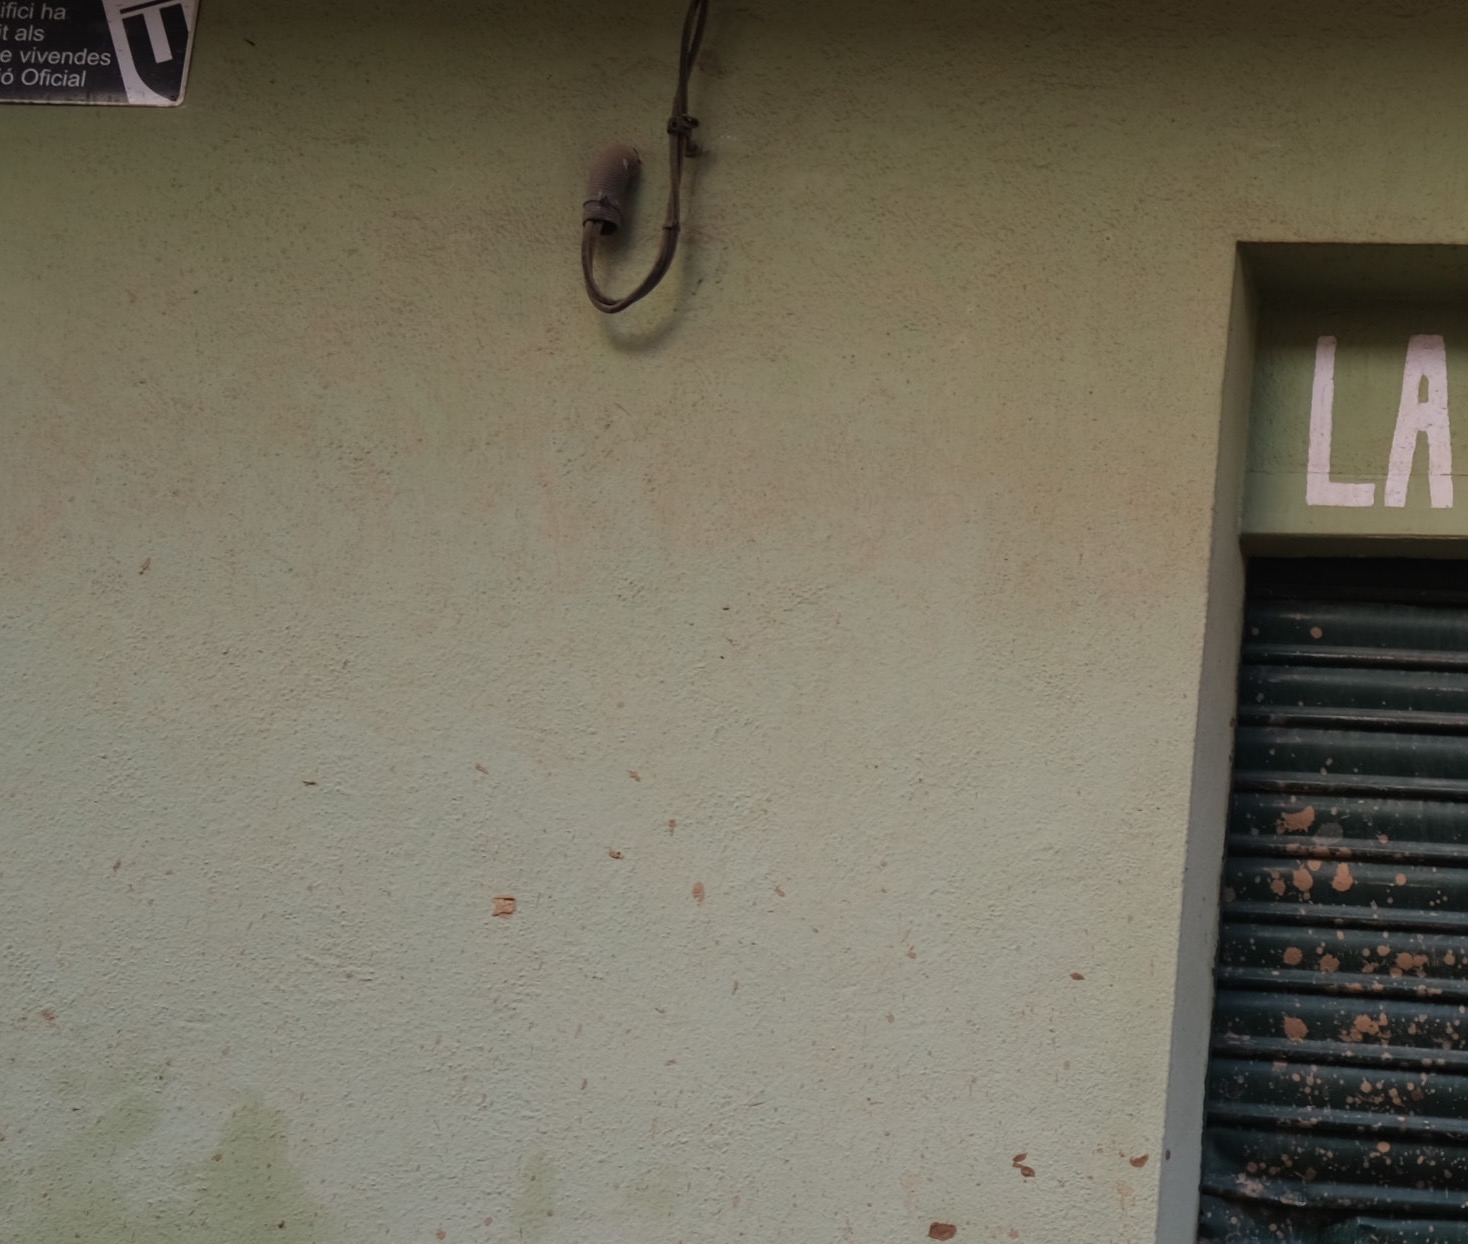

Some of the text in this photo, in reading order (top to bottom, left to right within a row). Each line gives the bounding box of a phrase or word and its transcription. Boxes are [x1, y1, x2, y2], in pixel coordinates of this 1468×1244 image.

[41, 3, 66, 20] ha
[15, 25, 45, 42] als
[20, 47, 111, 66] vivendes
[21, 68, 87, 88] Oficial
[1305, 336, 1455, 509] LA
